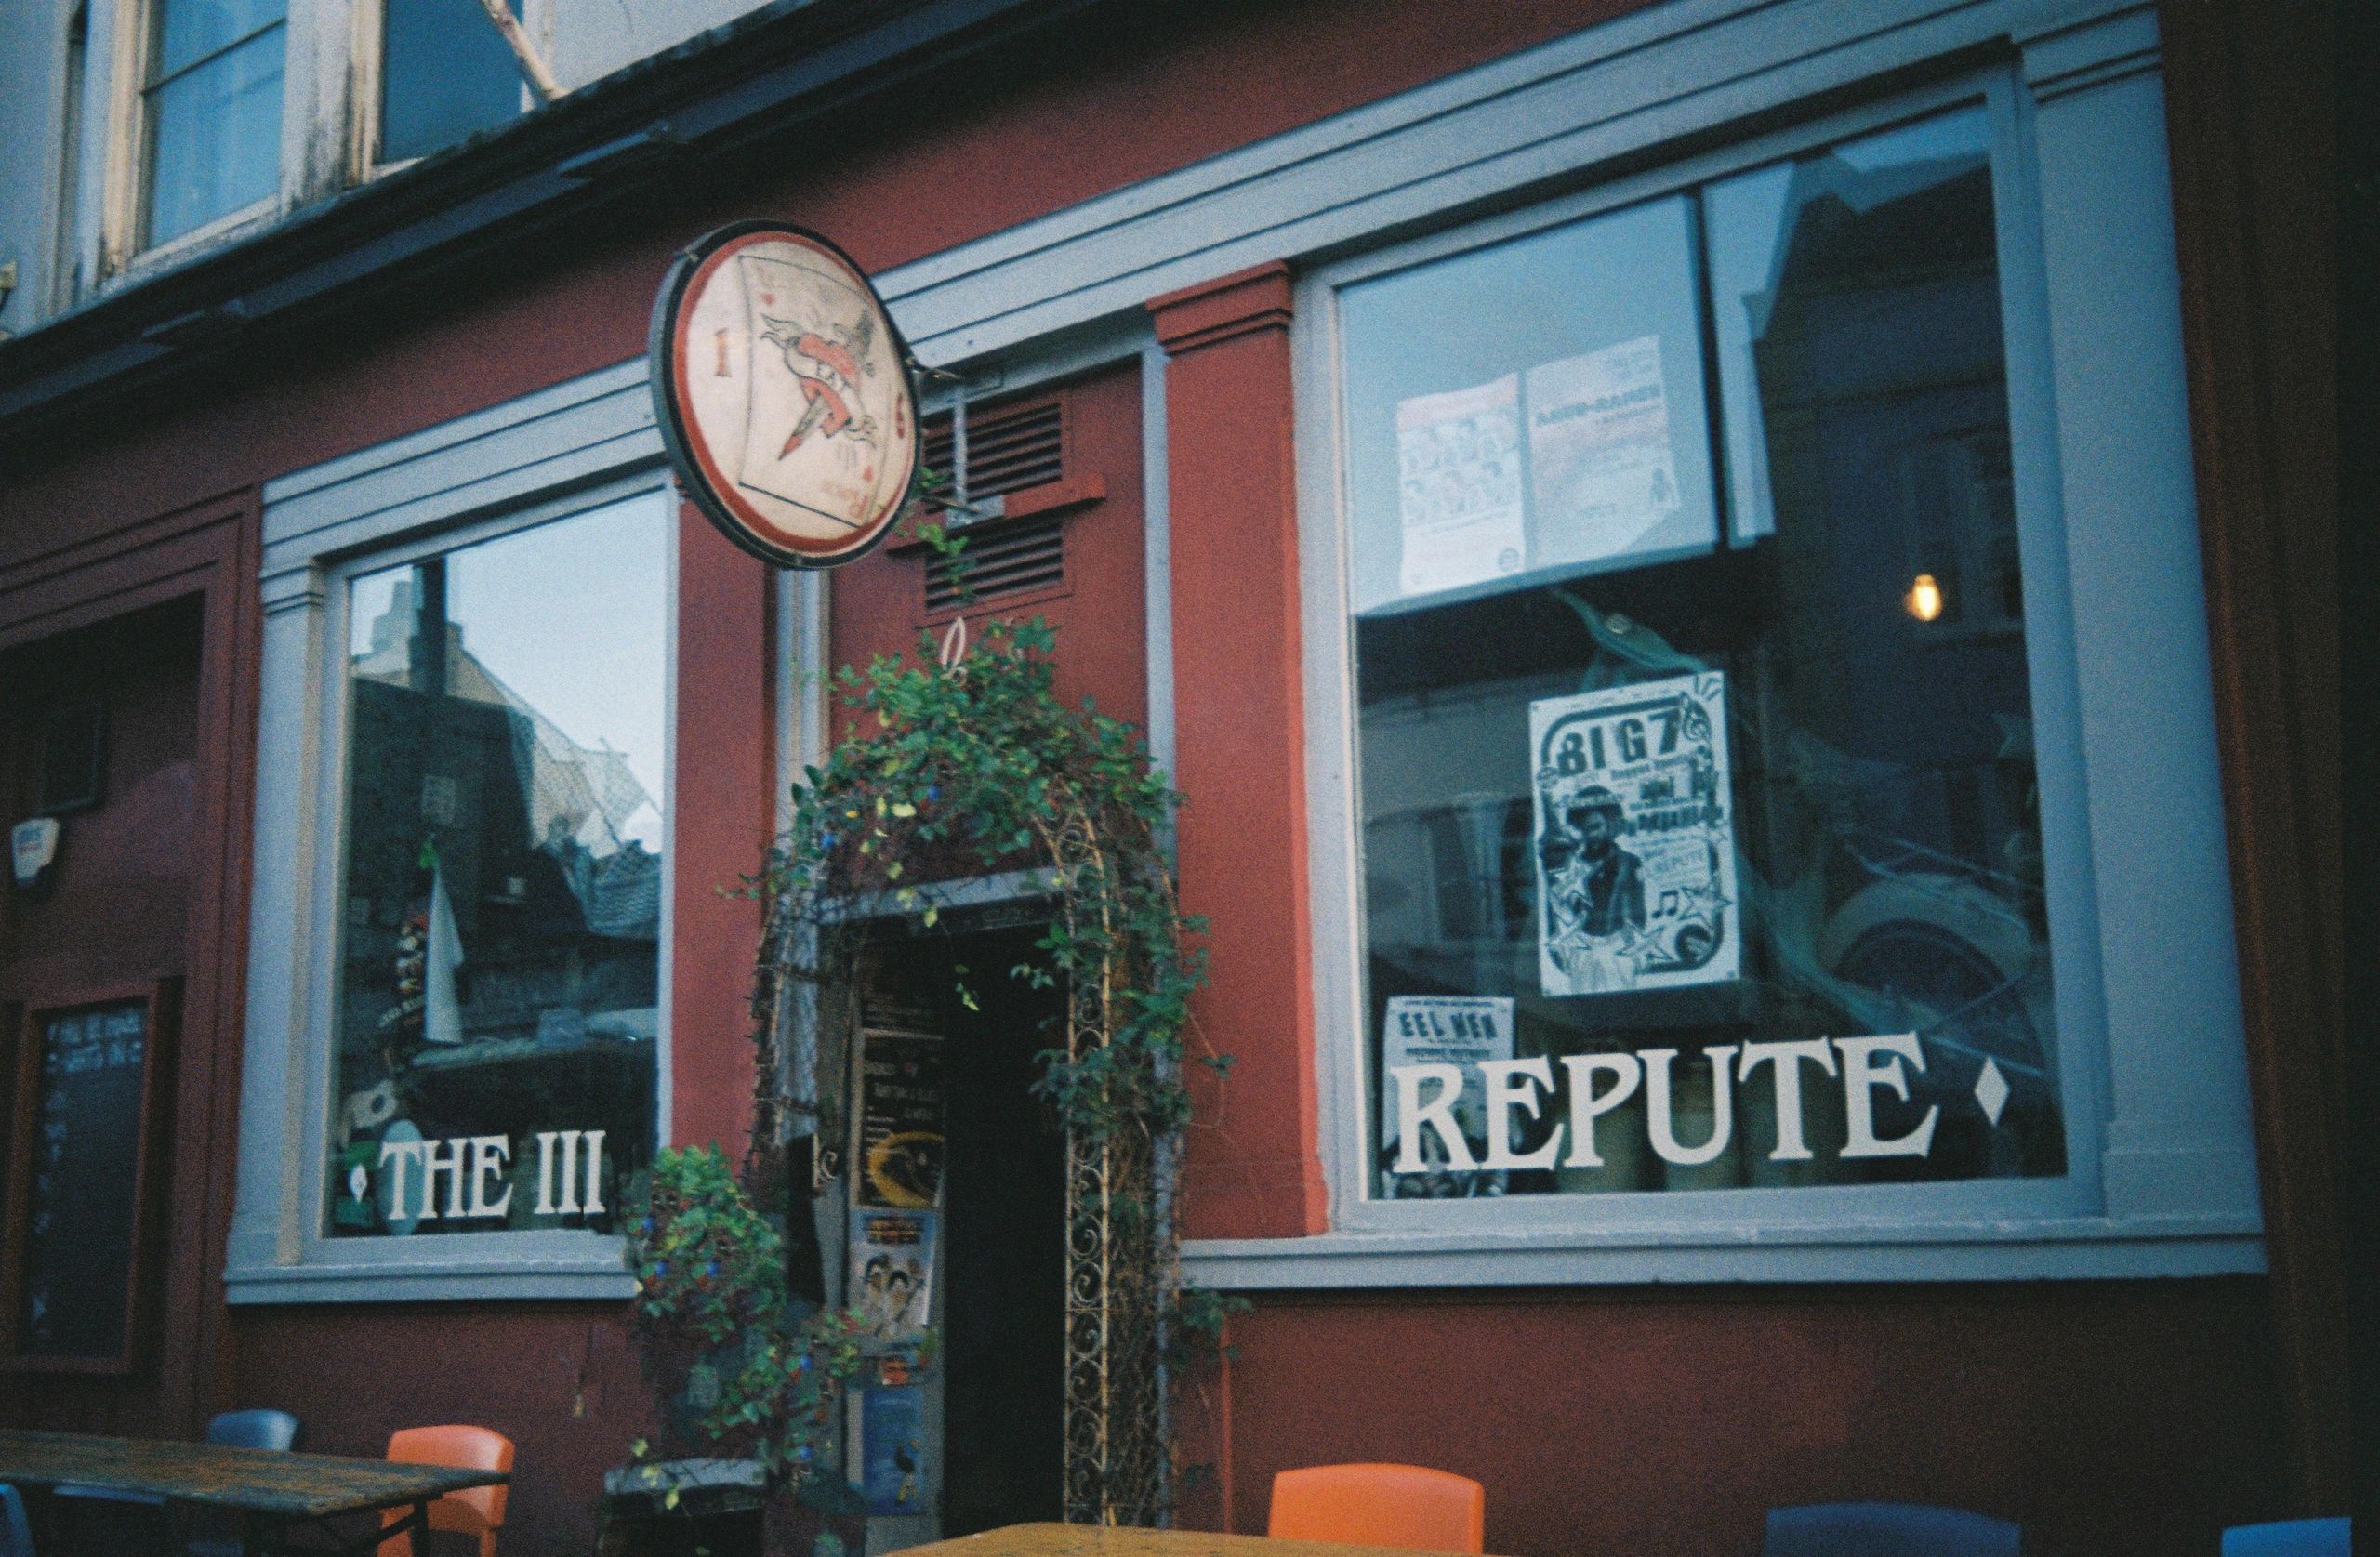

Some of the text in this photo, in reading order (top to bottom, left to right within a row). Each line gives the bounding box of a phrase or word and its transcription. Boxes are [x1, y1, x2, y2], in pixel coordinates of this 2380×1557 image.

[1398, 1010, 1446, 1039] EEL
[1391, 1032, 1939, 1173] REPUTE
[377, 1133, 513, 1220] THE
